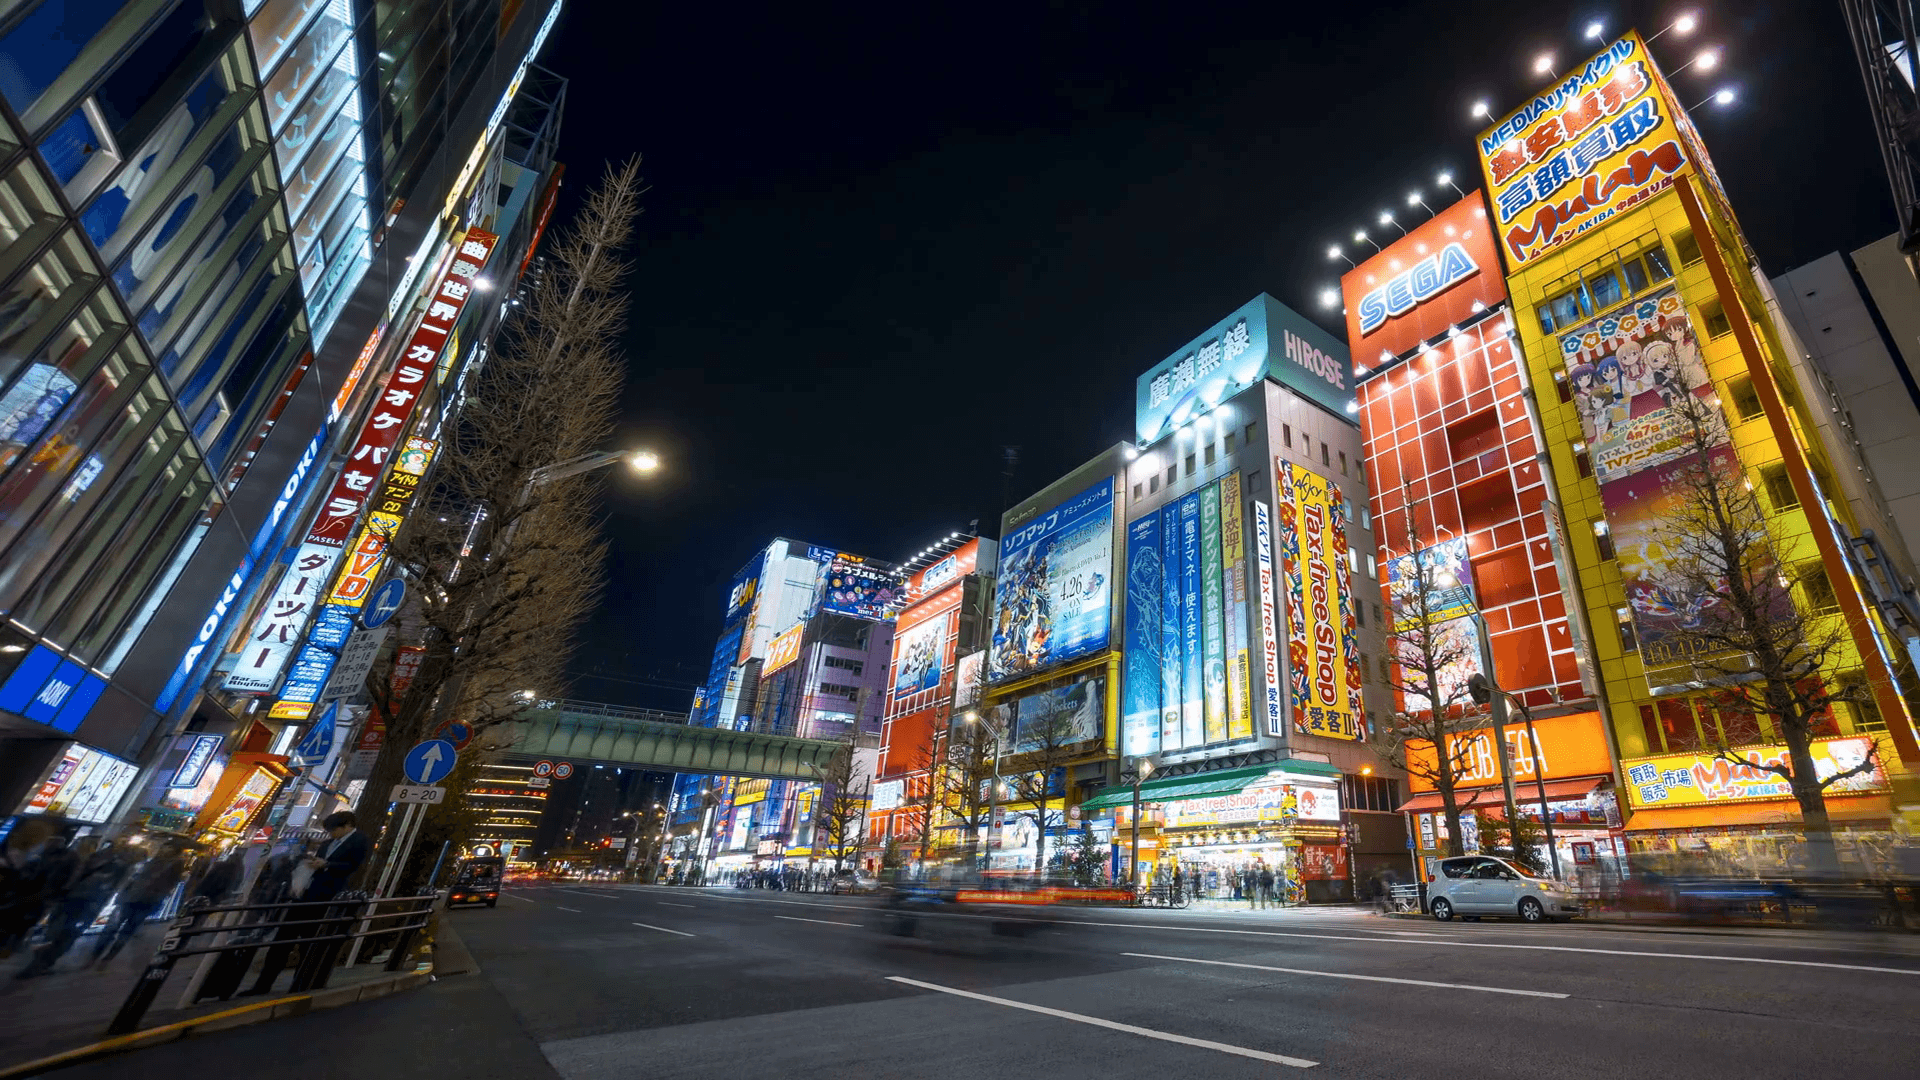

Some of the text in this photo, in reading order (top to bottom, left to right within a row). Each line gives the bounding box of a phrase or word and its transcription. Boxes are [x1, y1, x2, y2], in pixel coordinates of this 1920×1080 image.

[1498, 98, 1659, 222] 高額買取
[1505, 141, 1685, 262] Mulan
[1577, 208, 1616, 234] AKIBA
[1358, 242, 1478, 336] SEGA
[1148, 321, 1251, 409] 廣瀬無線
[1284, 328, 1346, 391] HIROSE
[272, 438, 319, 527] AOKI
[385, 486, 413, 499] アニメ
[390, 472, 419, 486] アイドル
[1294, 473, 1323, 502] AKKY
[382, 501, 401, 512] CD
[308, 535, 344, 546] PASELA
[1005, 511, 1060, 552] ソフマップ
[1551, 511, 1565, 547] GAME
[333, 533, 388, 601] DVD
[1060, 574, 1083, 601] 4.26
[184, 572, 243, 674] AOKI
[253, 554, 333, 668] ダーツバー
[1265, 639, 1276, 685] Shop
[37, 678, 72, 707] AOKI
[228, 679, 269, 689] Rhythm
[1450, 727, 1548, 781] CLUB EGA
[557, 766, 569, 775] 50
[1628, 763, 1660, 785] 買取
[1662, 768, 1692, 788] 市場
[1229, 793, 1257, 809] Shop
[1640, 784, 1668, 803] 販売
[1707, 786, 1746, 801] ムーラン
[1747, 784, 1779, 797] AKIBA
